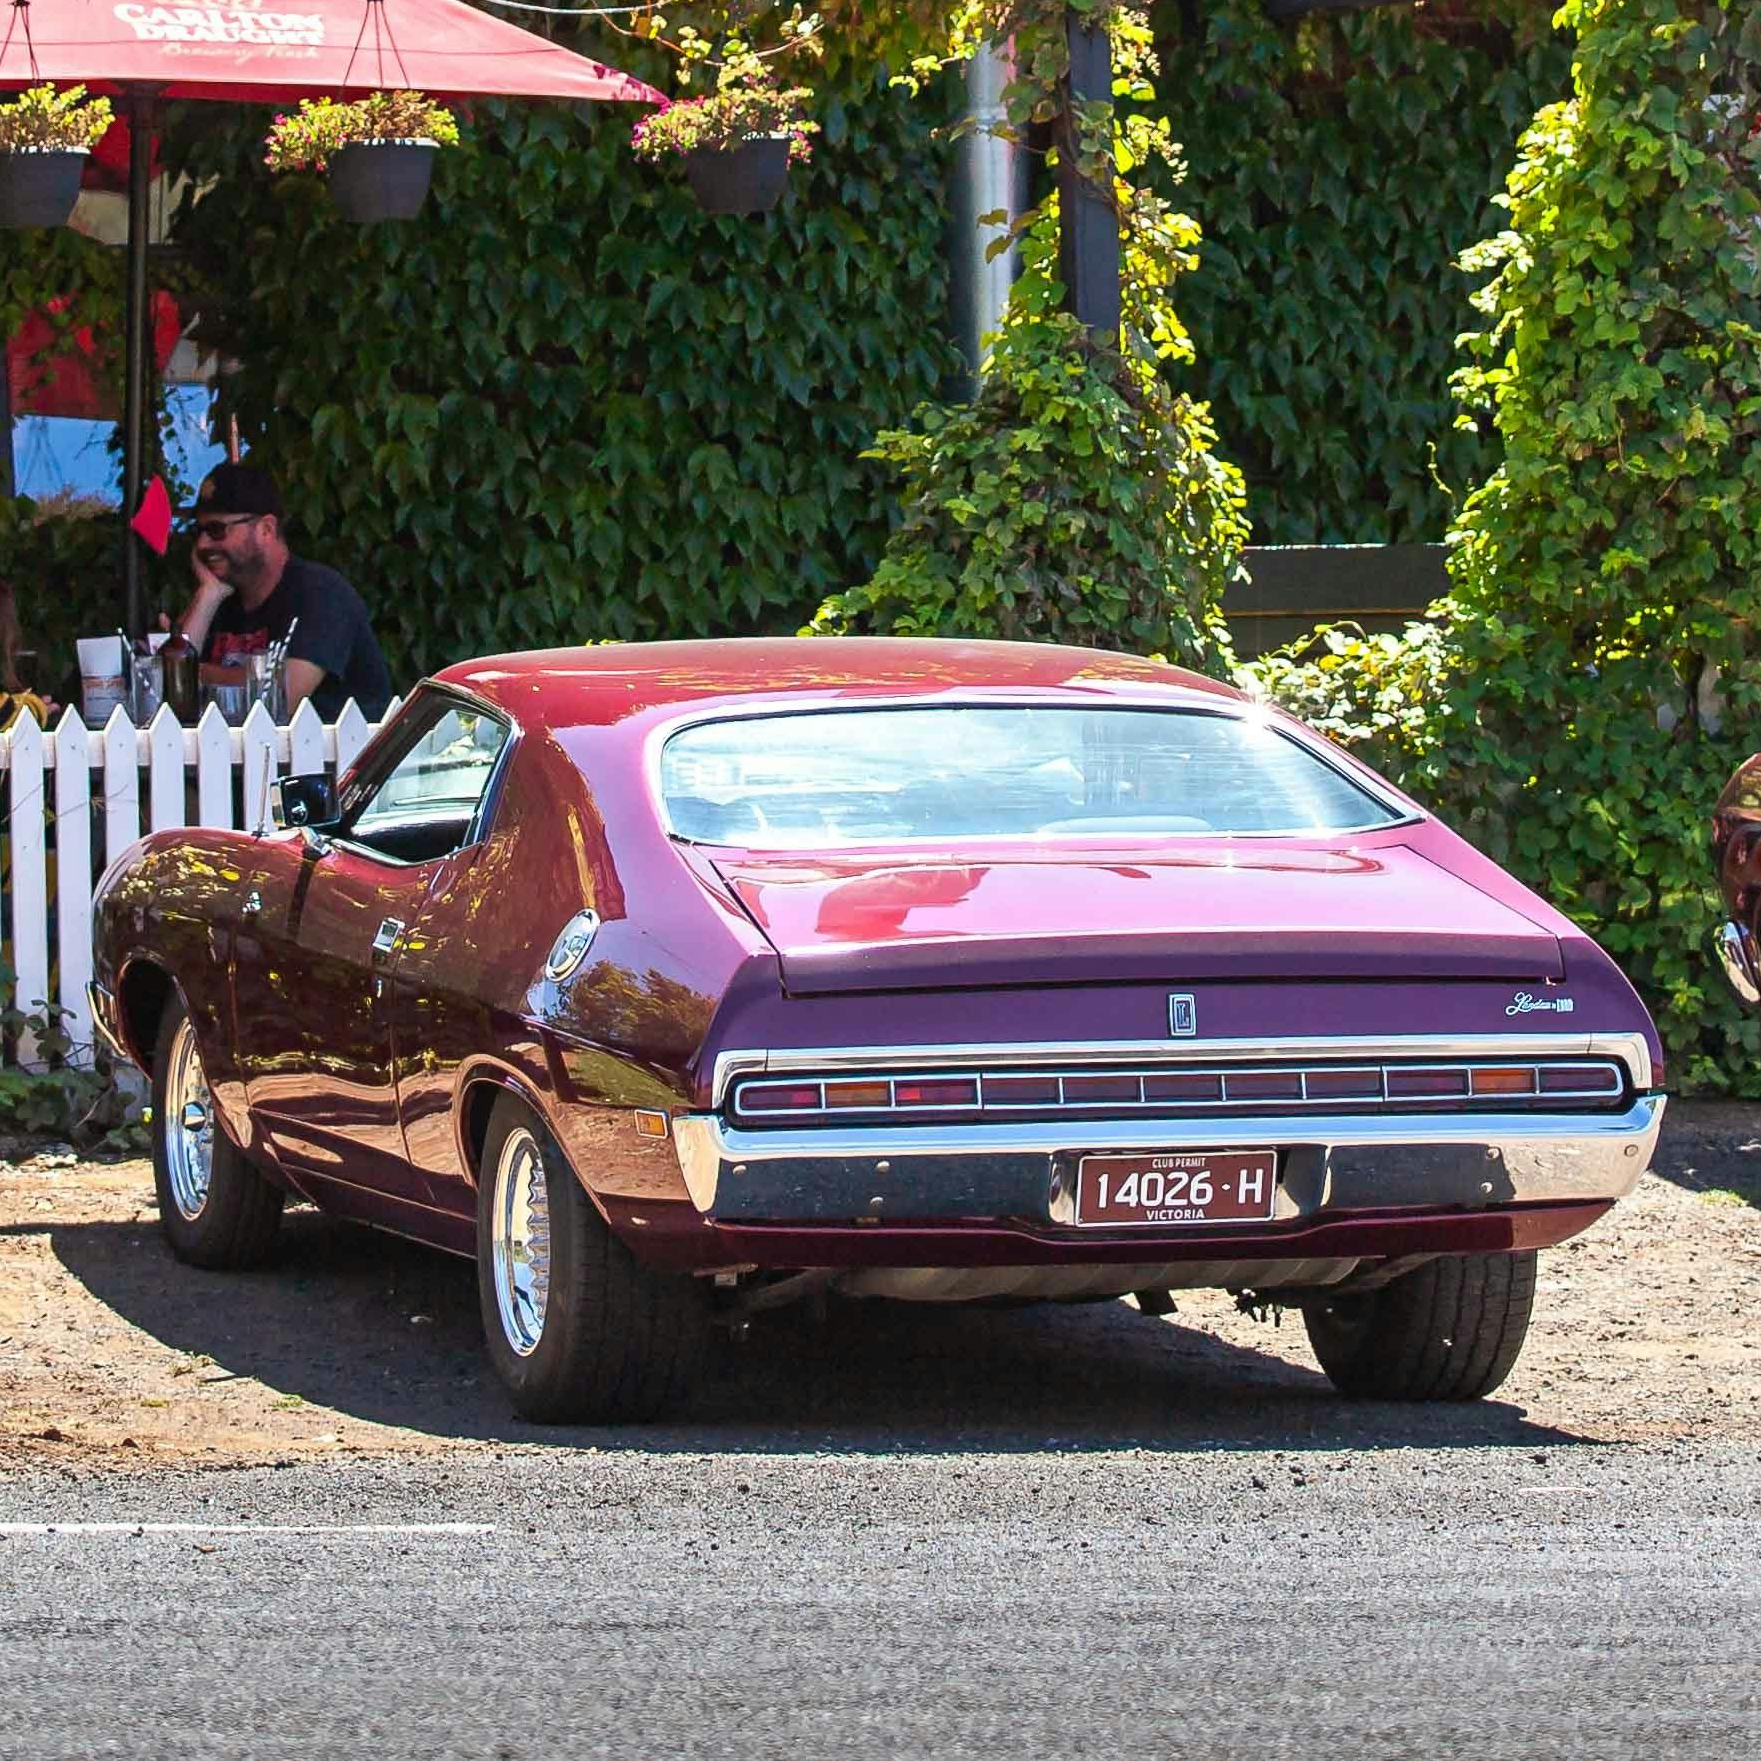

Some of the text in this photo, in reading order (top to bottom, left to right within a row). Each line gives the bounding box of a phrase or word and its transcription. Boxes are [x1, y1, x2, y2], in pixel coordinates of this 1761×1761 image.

[113, 3, 325, 31] CARLTON
[1152, 1157, 1206, 1169] CLUB PERMIT
[1146, 1208, 1205, 1221] VICTORIA
